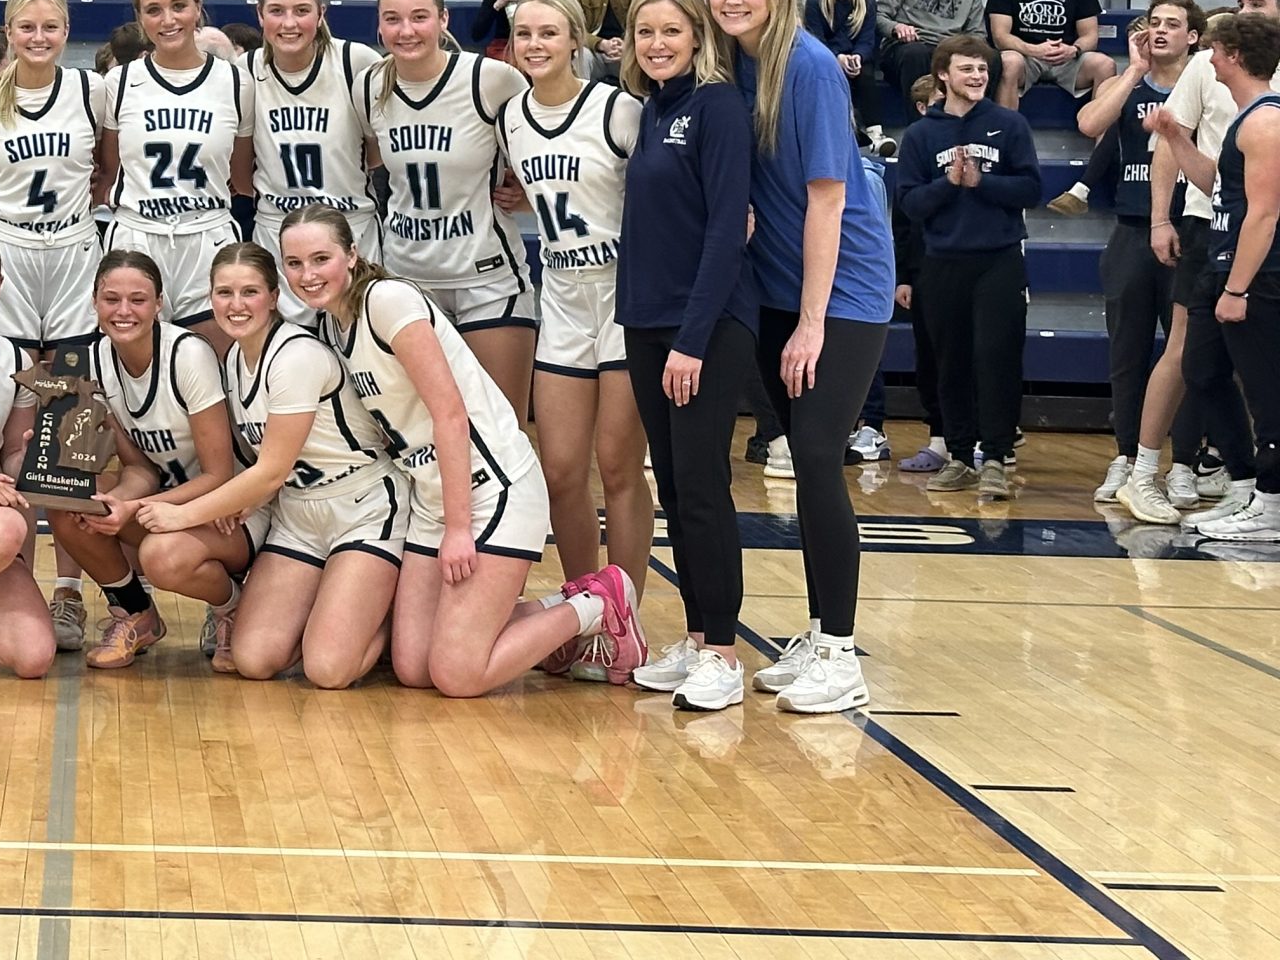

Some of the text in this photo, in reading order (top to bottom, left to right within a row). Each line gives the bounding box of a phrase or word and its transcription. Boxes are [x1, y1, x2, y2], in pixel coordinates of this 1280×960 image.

[1019, 2, 1066, 17] WORD
[144, 108, 213, 134] SOUTH
[269, 106, 330, 133] SOUTH
[4, 132, 70, 164] SOUTH
[389, 124, 453, 152] SOUTH
[144, 140, 208, 189] 24
[279, 142, 324, 190] 10
[522, 154, 580, 185] SOUTH
[936, 147, 958, 168] SOUT
[26, 168, 58, 214] 4
[405, 161, 442, 211] 11
[389, 210, 474, 242] CHRISTIAN
[535, 191, 590, 242] 14
[37, 412, 54, 470] CHAMPION
[71, 451, 97, 462] 2024
[25, 471, 90, 488] Girls Basketball
